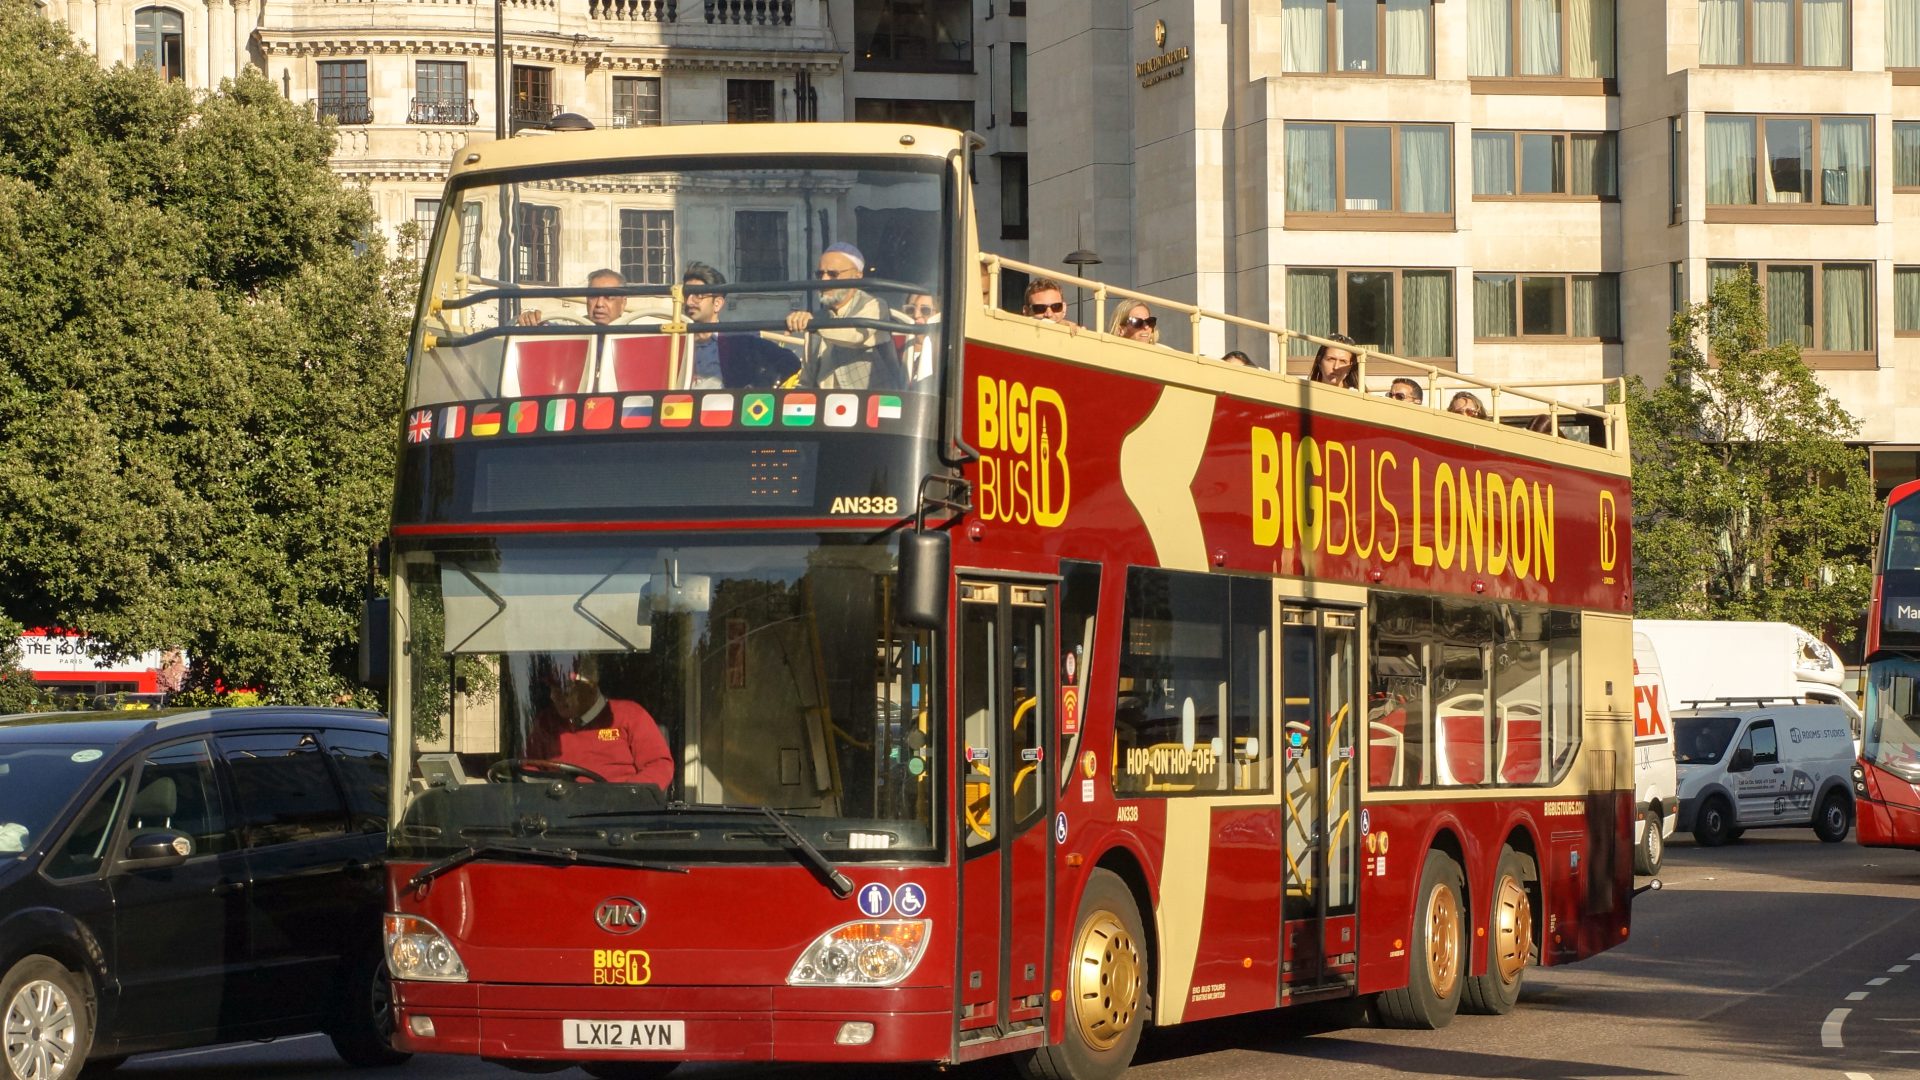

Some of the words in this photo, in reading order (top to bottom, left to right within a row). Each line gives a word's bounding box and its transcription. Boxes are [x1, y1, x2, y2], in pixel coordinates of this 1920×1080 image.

[978, 375, 1030, 454] BIG
[979, 455, 1031, 525] BUS
[830, 497, 898, 514] AN338
[1412, 456, 1555, 583] LONDON
[27, 644, 51, 654] THE
[1801, 731, 1821, 739] ROOMS
[1127, 748, 1168, 774] HOP-ON
[1171, 748, 1216, 774] HOP-OFF
[1116, 806, 1139, 822] AN338
[593, 950, 625, 968] BIG
[593, 969, 626, 985] BUS
[576, 1023, 623, 1045] LX12
[629, 1023, 672, 1046] AYN
